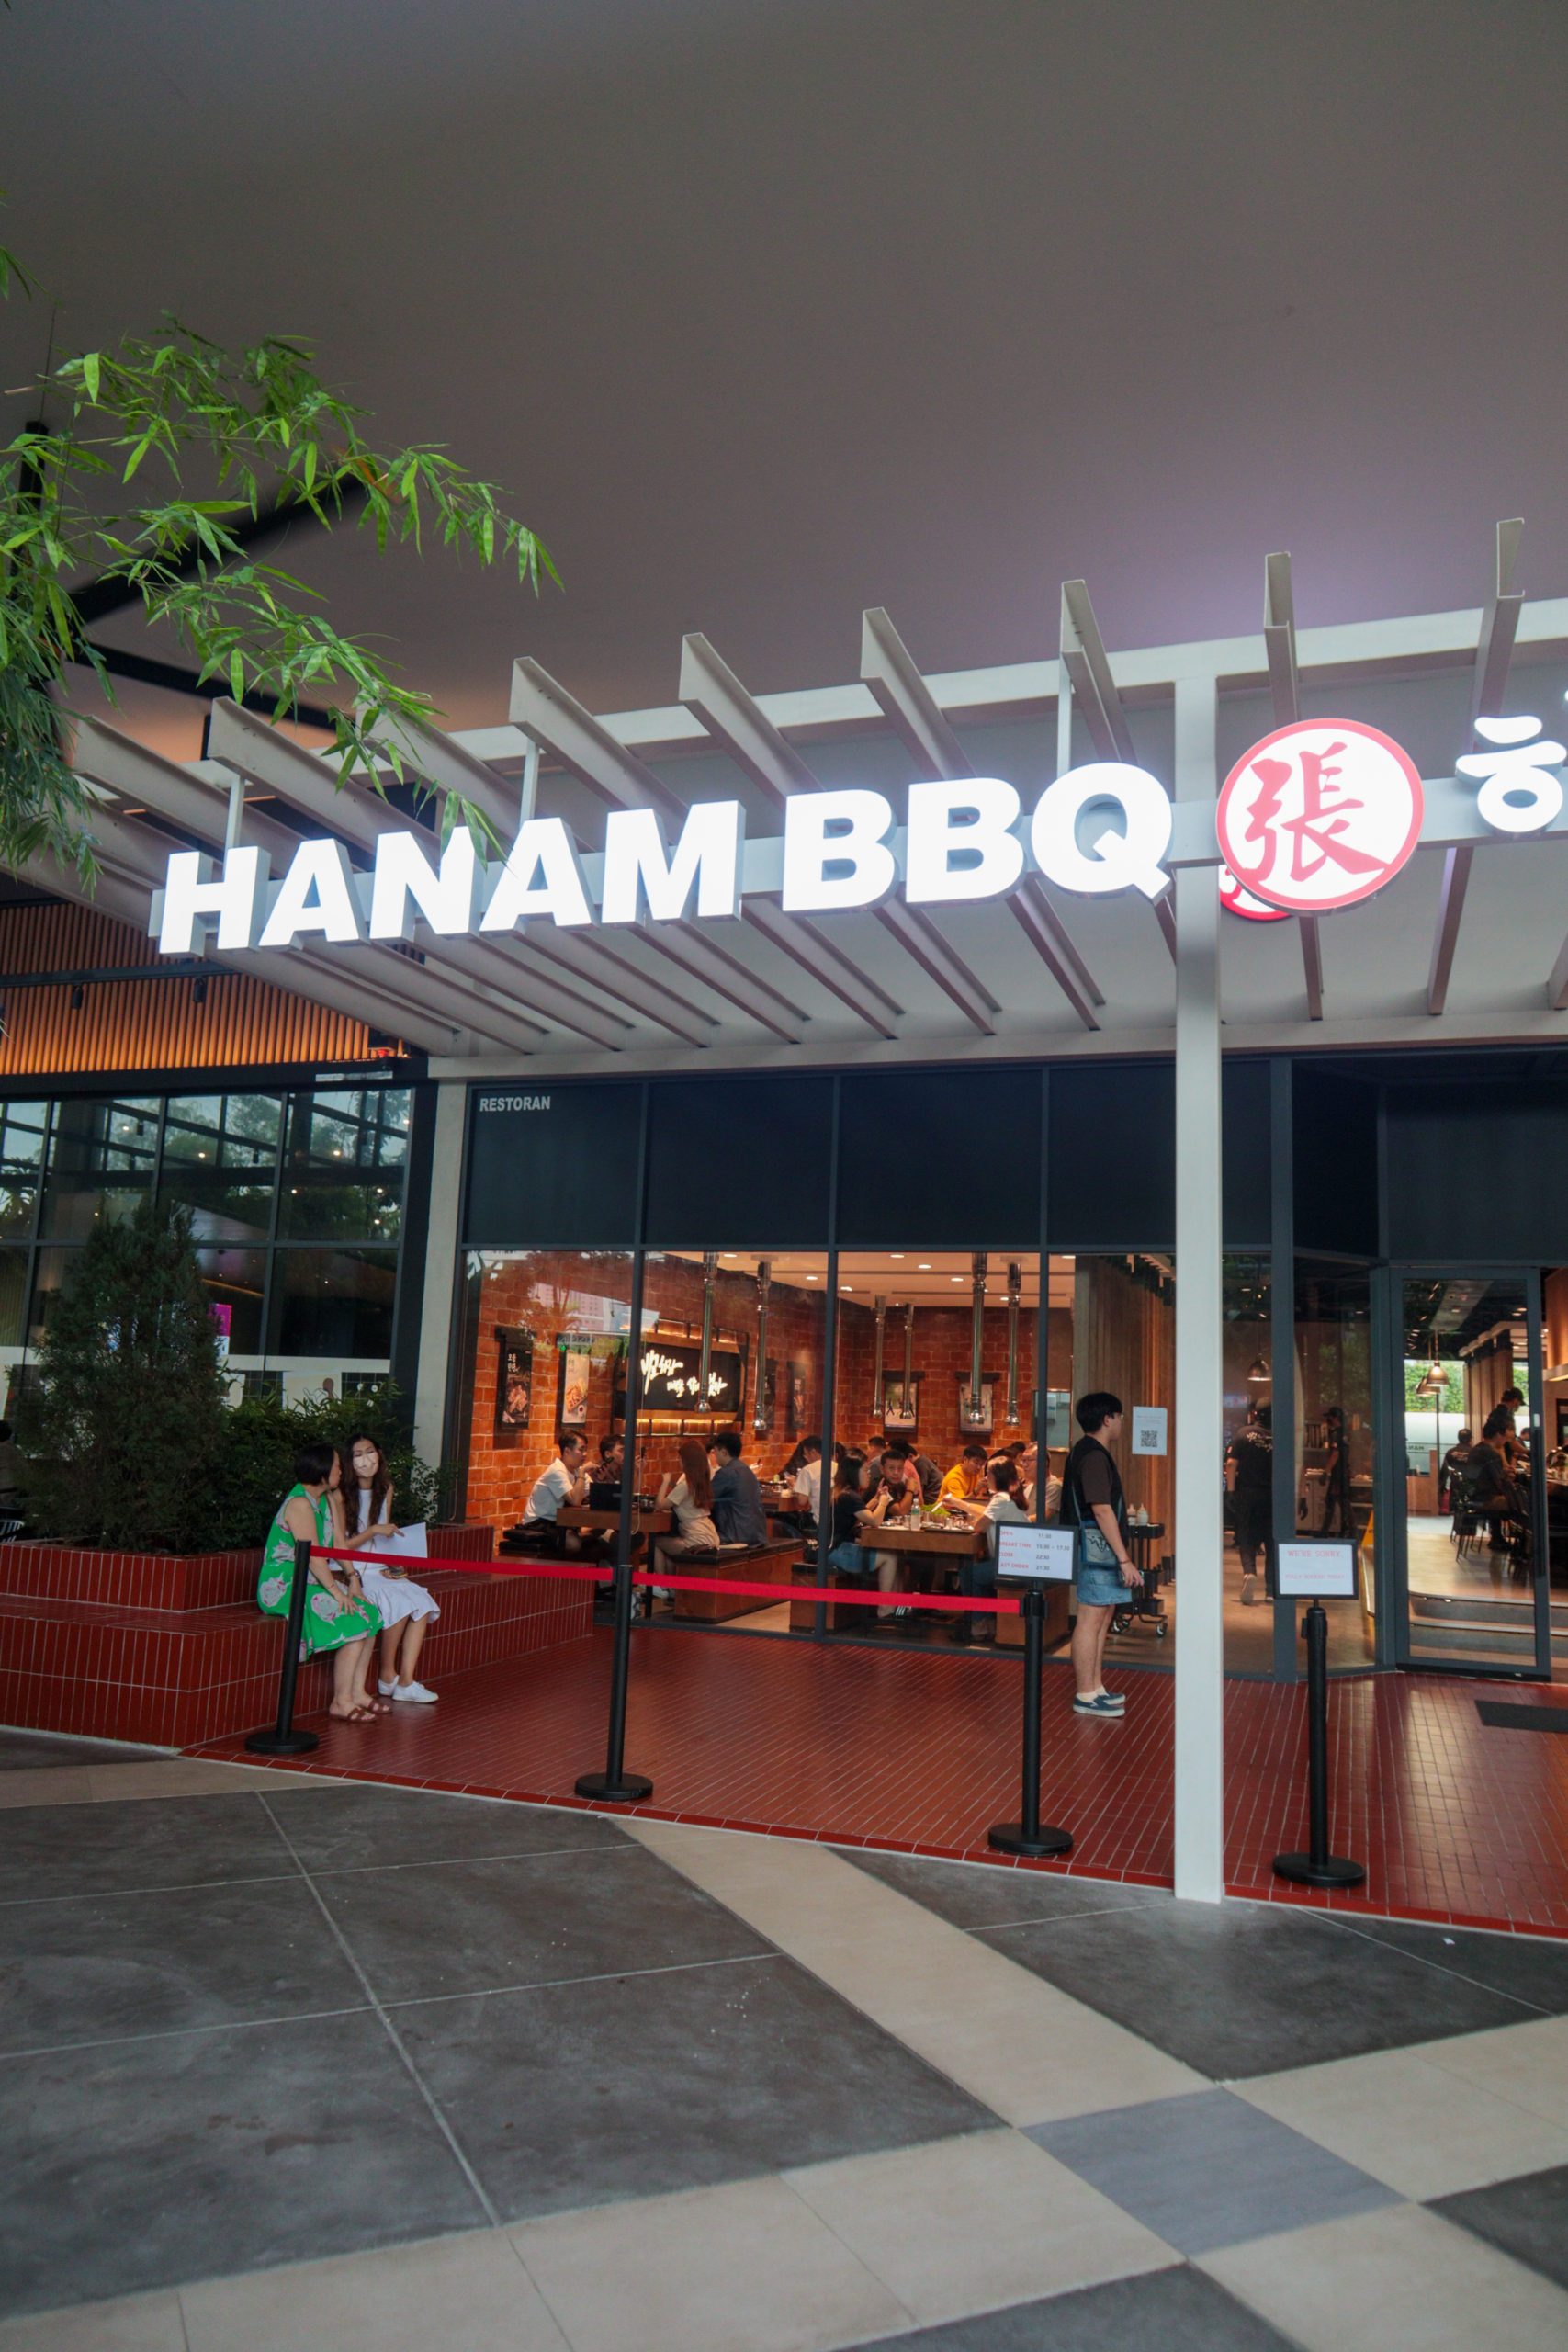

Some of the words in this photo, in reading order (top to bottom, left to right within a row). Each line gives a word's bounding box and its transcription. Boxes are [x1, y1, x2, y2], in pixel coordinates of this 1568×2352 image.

[158, 798, 744, 955] HANAM
[781, 761, 1174, 911] BBQ
[479, 1095, 551, 1112] RESTORAN
